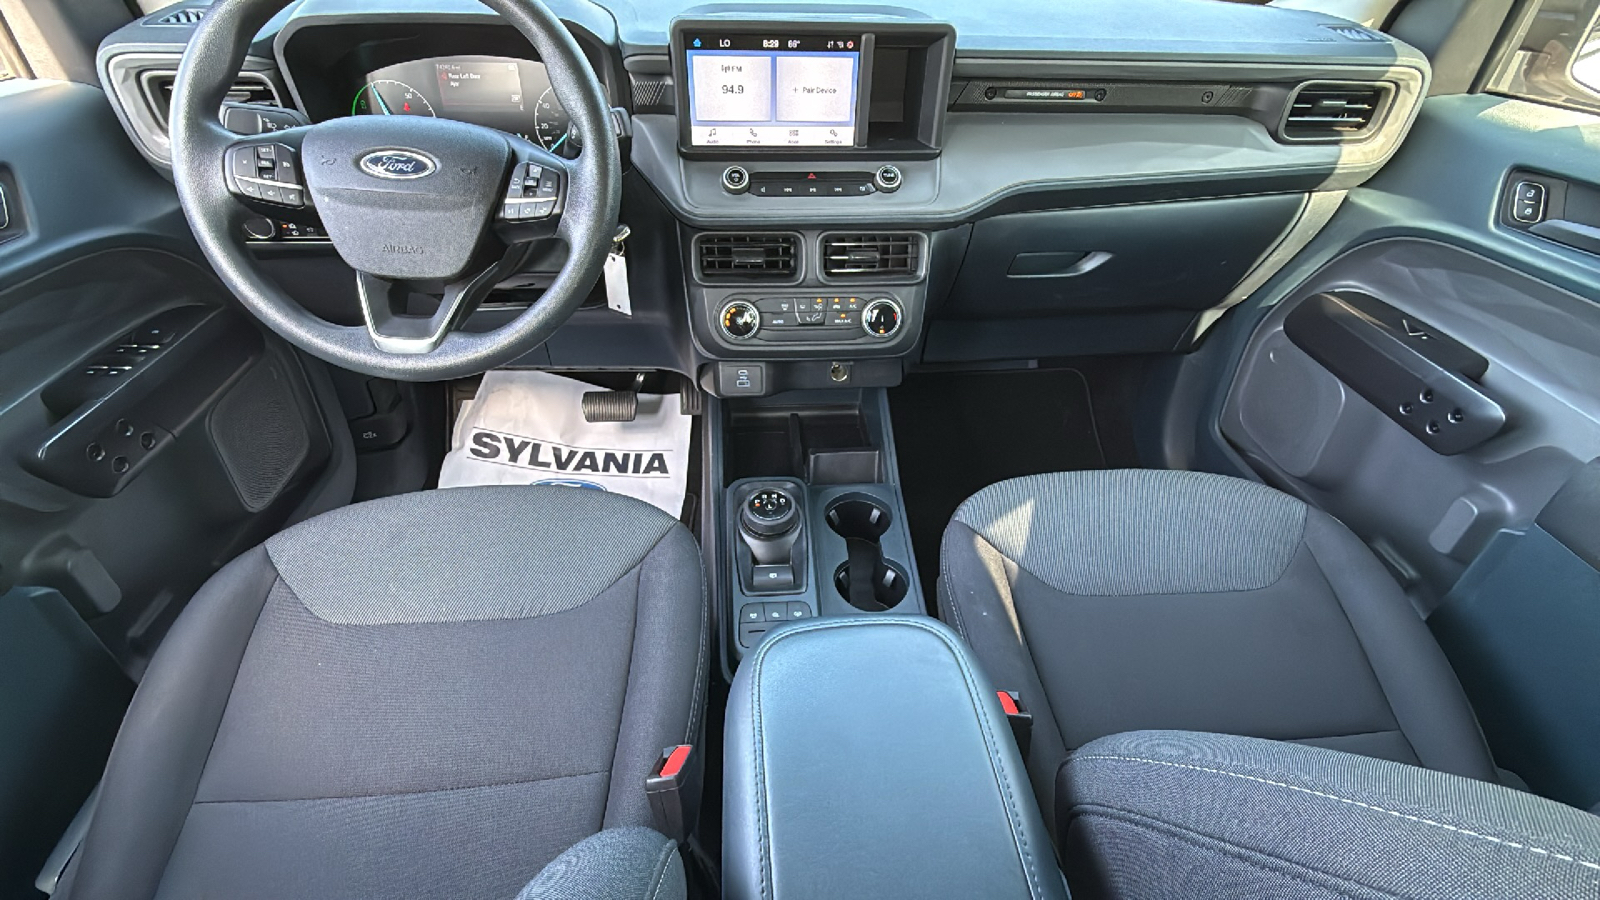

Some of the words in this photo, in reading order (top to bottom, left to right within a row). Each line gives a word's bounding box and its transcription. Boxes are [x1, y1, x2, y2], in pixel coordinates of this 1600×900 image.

[719, 39, 731, 48] LO
[762, 39, 780, 49] 8:29
[721, 84, 745, 95] 94.9
[802, 86, 816, 95] Pair
[816, 86, 837, 95] Device
[541, 122, 549, 130] 20
[382, 244, 424, 255] AIRBAG
[469, 431, 669, 475] SYLVANIA
